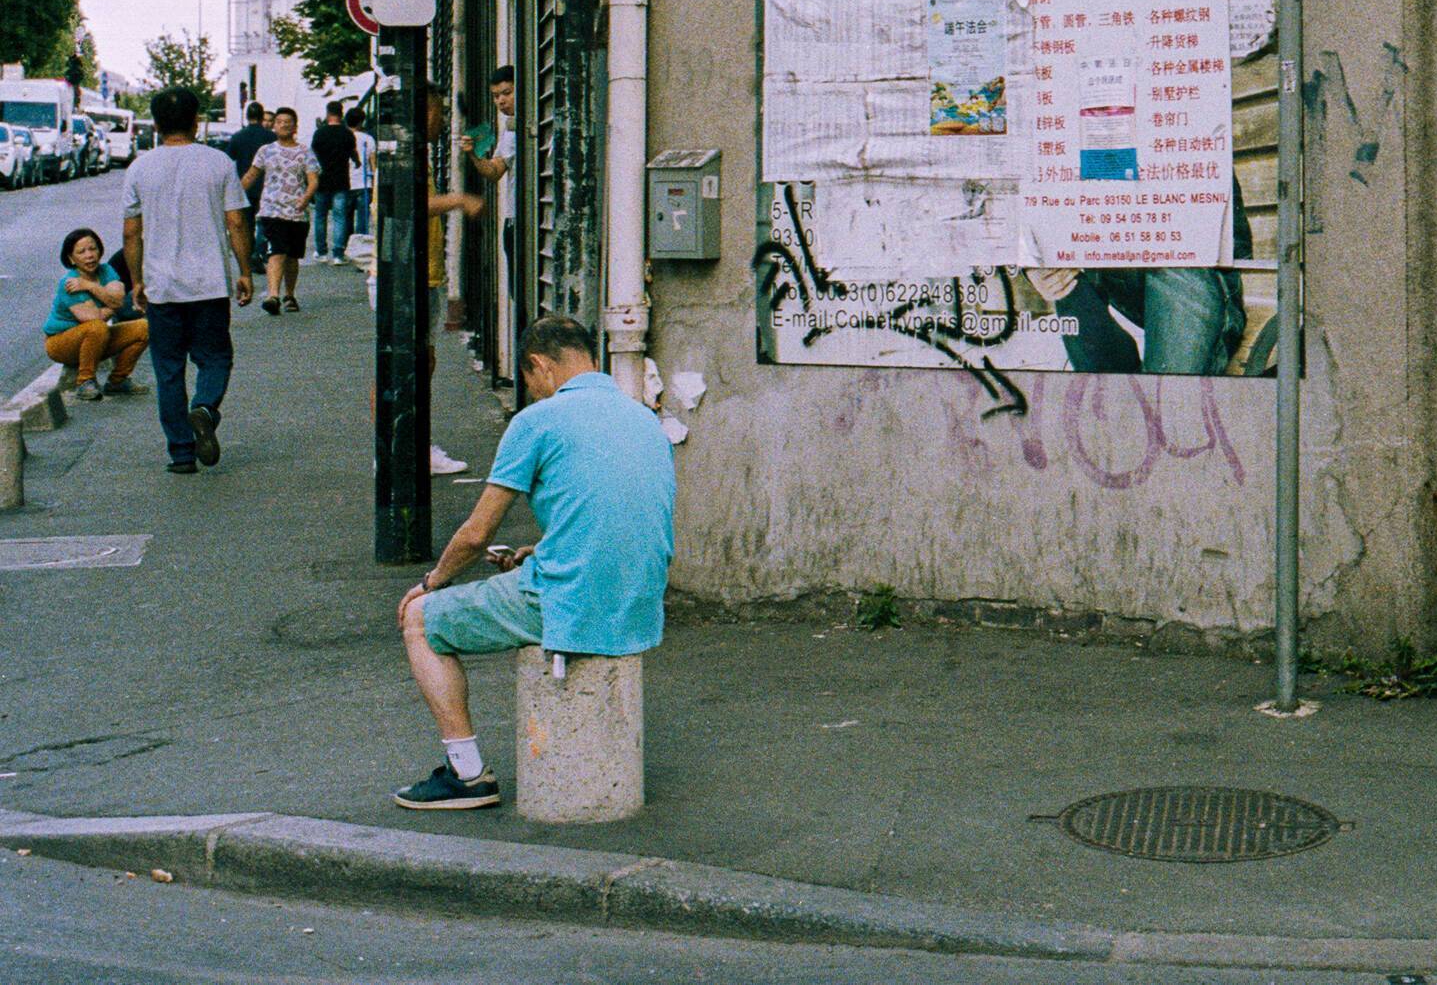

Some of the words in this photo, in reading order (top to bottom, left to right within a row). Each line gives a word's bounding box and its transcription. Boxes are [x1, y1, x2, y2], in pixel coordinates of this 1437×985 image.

[1024, 196, 1038, 207] 7/9
[1042, 195, 1060, 207] Rue
[1064, 195, 1076, 207] du
[1080, 195, 1101, 206] Parc
[1103, 194, 1131, 206] 93150
[1136, 194, 1148, 205] LE
[1153, 193, 1186, 205] BLANC
[1190, 192, 1227, 204] MESNIL
[1100, 213, 1111, 224] 09
[1115, 213, 1126, 224] 54
[1131, 213, 1142, 224] 05
[1146, 213, 1157, 224] 78
[1161, 212, 1172, 223] 81
[1109, 232, 1121, 243] 06
[1125, 231, 1135, 242] 51
[1140, 231, 1152, 243] 58
[1155, 231, 1166, 242] 80
[1170, 231, 1182, 242] 53
